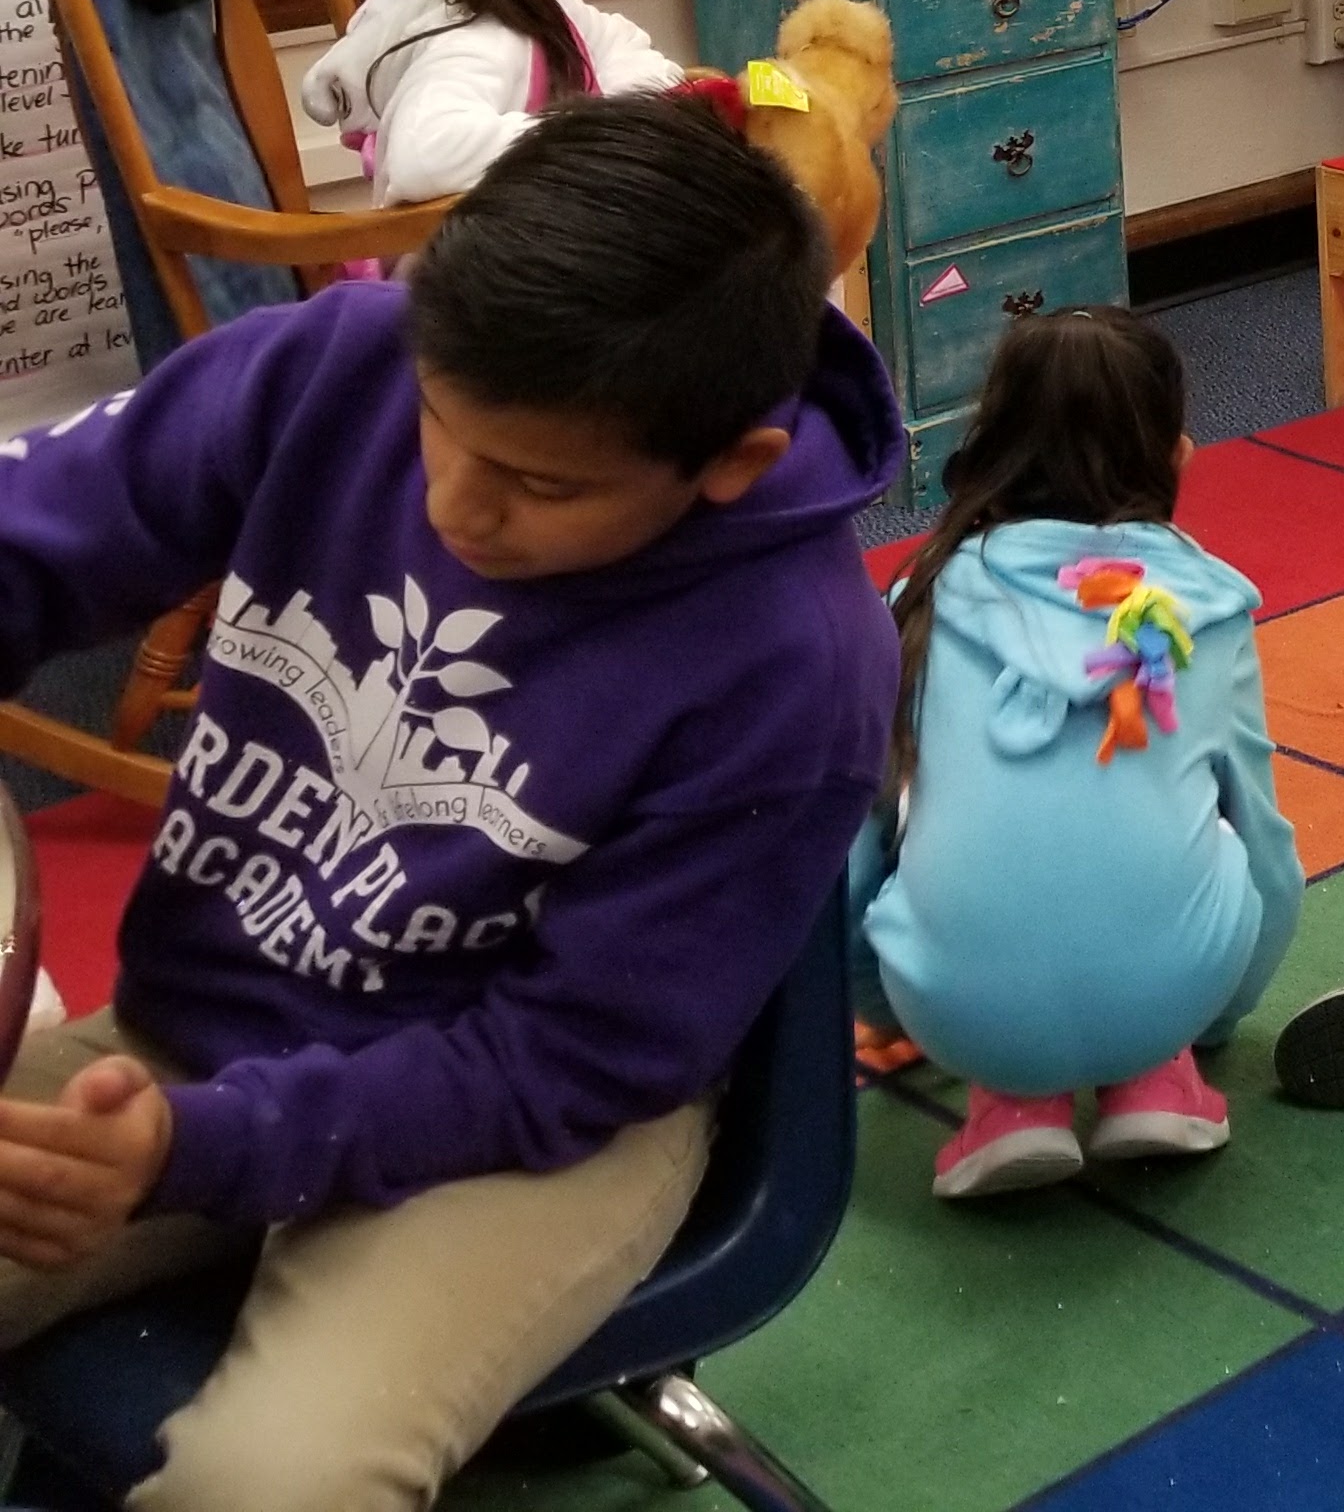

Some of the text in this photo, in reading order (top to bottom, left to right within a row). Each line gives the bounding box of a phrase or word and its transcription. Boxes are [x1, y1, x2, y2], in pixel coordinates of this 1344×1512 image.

[64, 251, 102, 277] the
[34, 272, 108, 306] words
[35, 308, 72, 327] are
[69, 331, 91, 358] at
